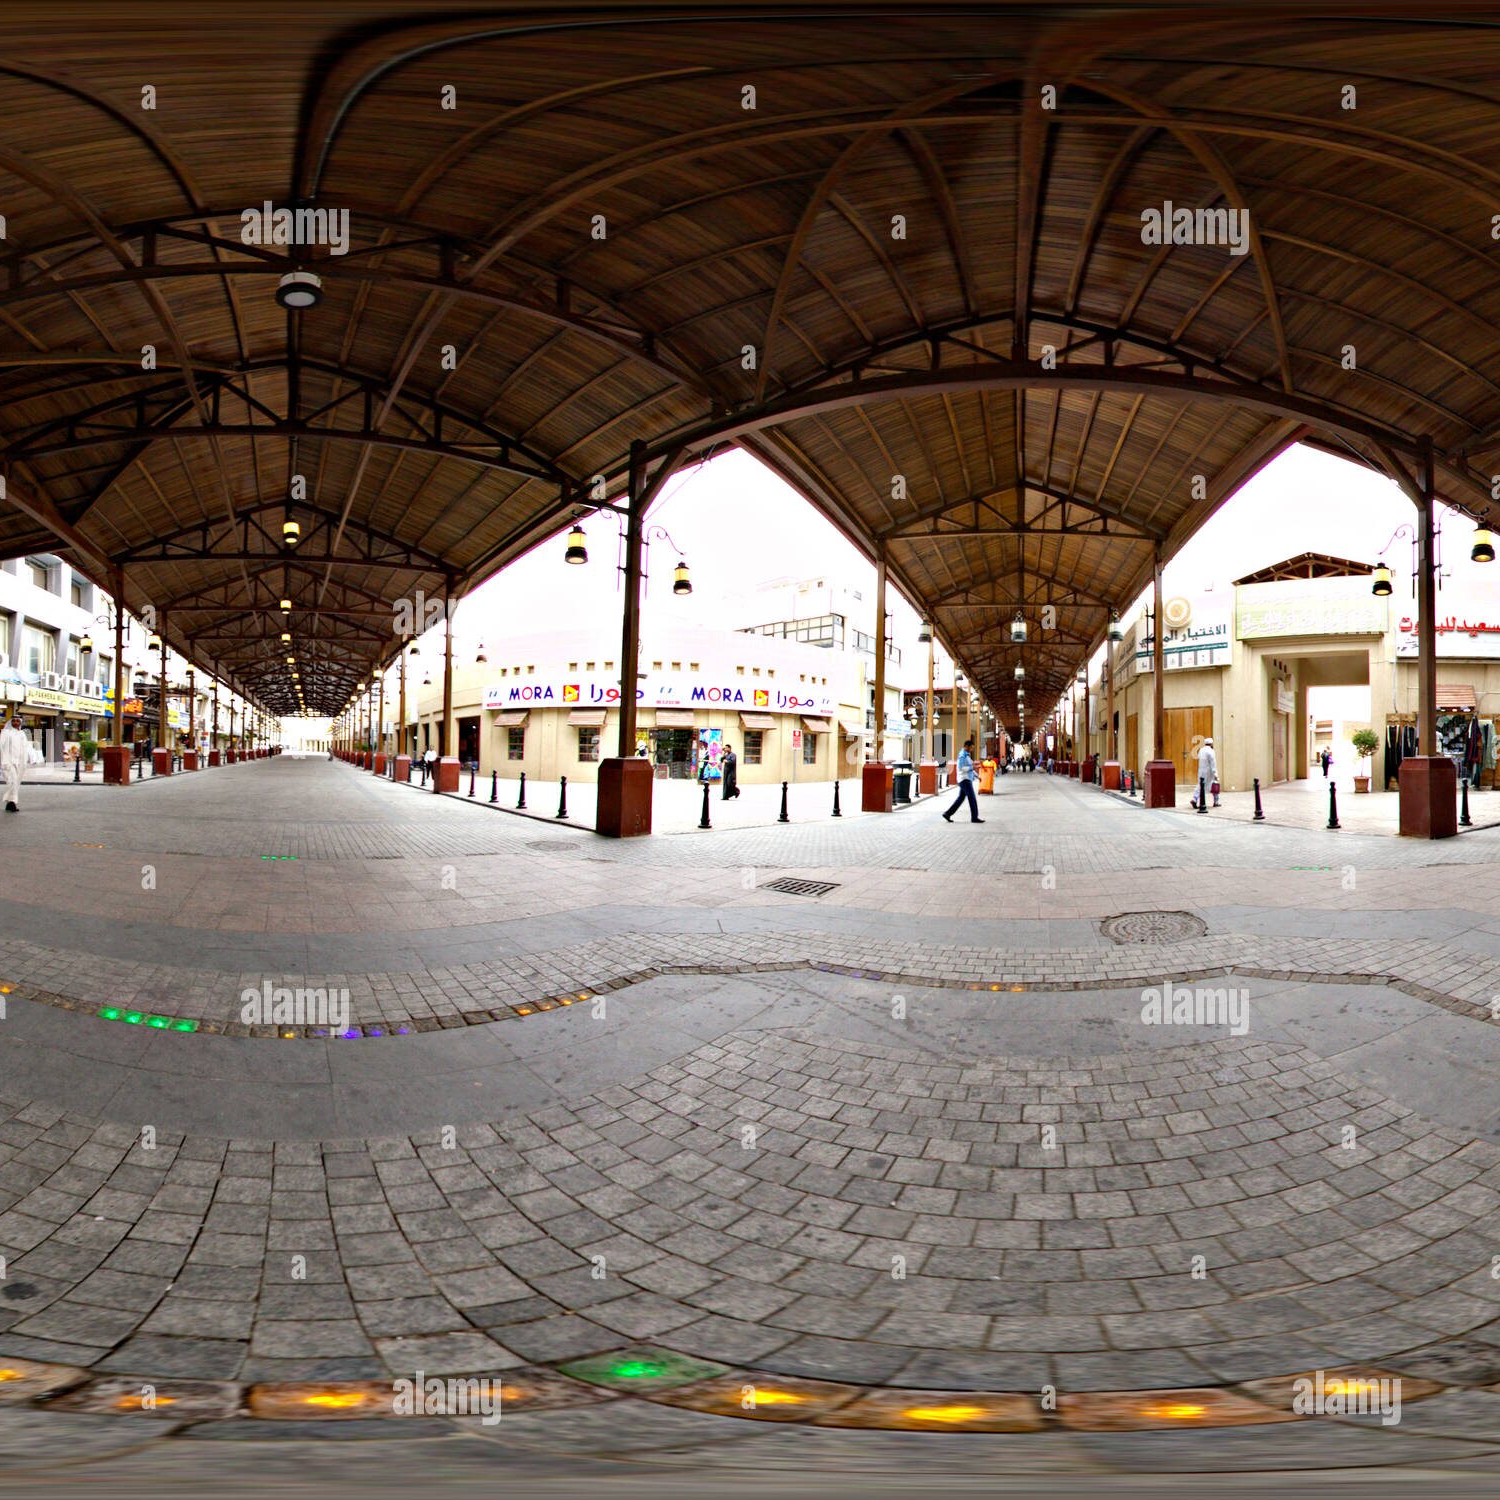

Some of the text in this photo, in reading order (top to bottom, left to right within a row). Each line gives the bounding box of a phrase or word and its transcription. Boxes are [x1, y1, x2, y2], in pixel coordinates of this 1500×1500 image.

[1181, 623, 1227, 643] الاختيار
[509, 686, 554, 701] MORA
[691, 687, 744, 703] MORA
[777, 690, 815, 709] مورا
